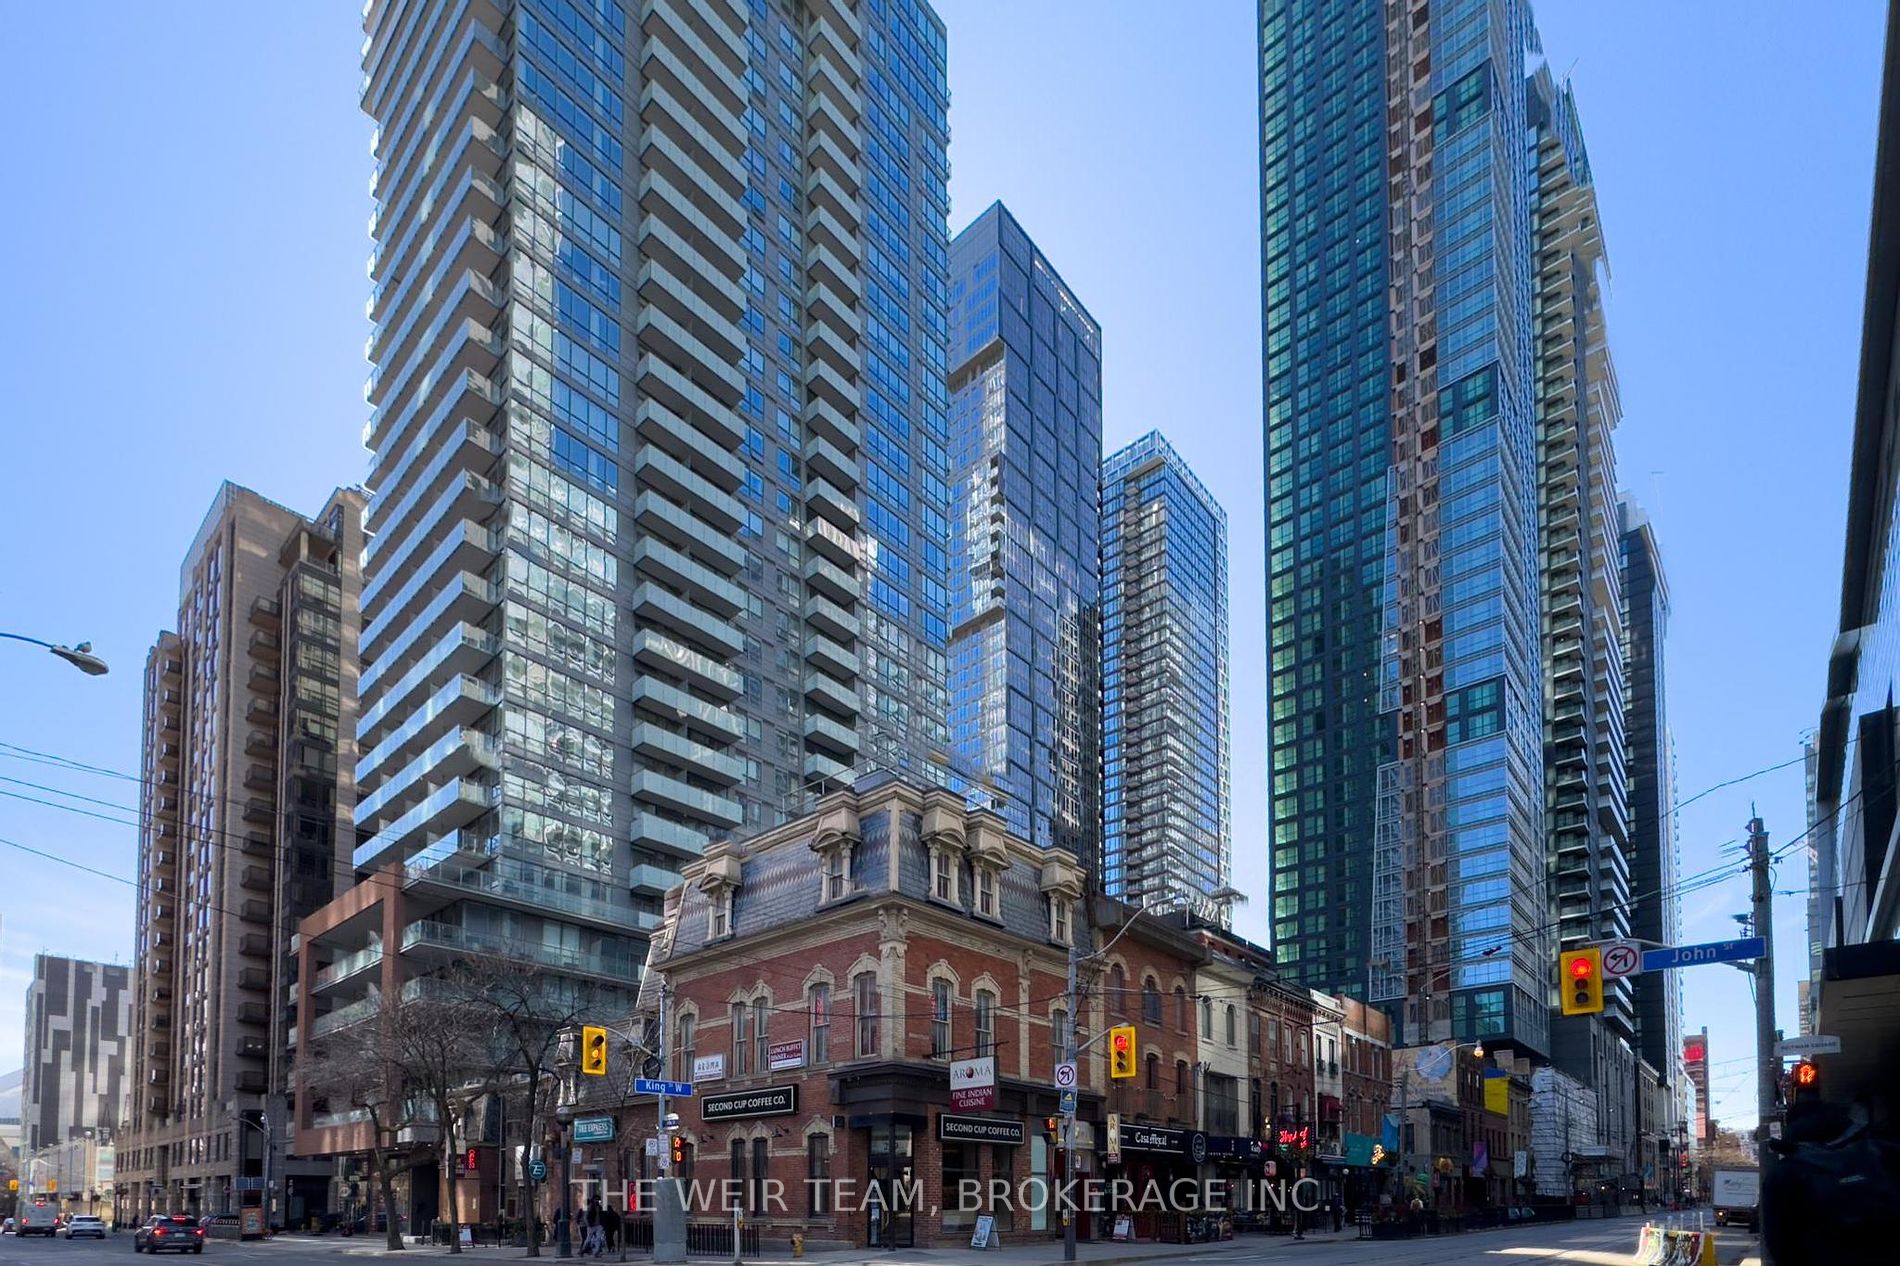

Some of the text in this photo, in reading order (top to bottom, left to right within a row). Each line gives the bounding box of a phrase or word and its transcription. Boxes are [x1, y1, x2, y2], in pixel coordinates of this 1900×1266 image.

[1672, 947, 1716, 963] John
[697, 1061, 720, 1071] AROMA
[952, 1065, 992, 1080] AROMA
[645, 1080, 666, 1093] King
[675, 1083, 683, 1092] W
[952, 1087, 993, 1100] FINE INDIAN
[707, 1095, 786, 1112] SECOND CUP COFFEE CO.
[958, 1097, 986, 1108] CUISINE
[945, 1122, 973, 1133] SECOND
[973, 1125, 987, 1134] CUP
[987, 1126, 1010, 1136] COFFEE
